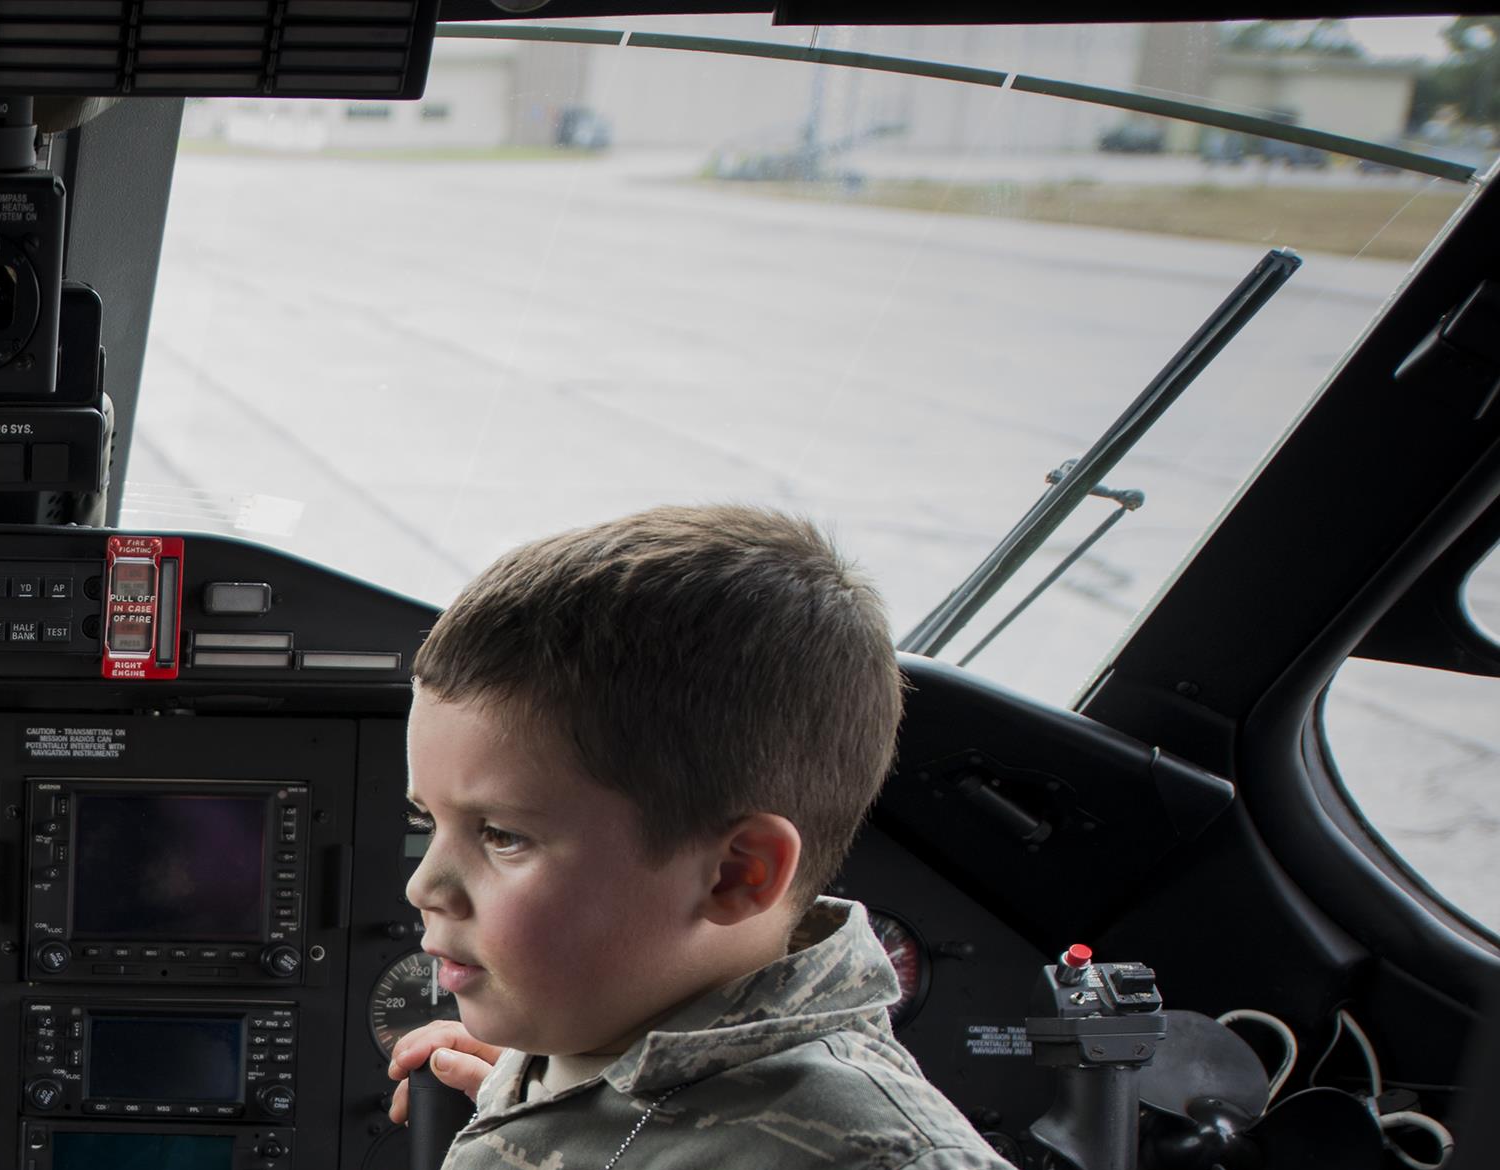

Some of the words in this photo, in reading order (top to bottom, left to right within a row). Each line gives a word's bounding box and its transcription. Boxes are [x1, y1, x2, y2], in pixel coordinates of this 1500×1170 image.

[2, 203, 35, 212] HEATING
[25, 212, 38, 221] ON
[10, 424, 34, 435] SYS.
[118, 546, 153, 554] FIGHTING
[20, 583, 33, 593] YD
[53, 583, 66, 593] AP
[110, 594, 133, 603] PULL
[137, 594, 156, 604] OFF
[113, 604, 124, 613] IN
[128, 604, 153, 613] CASE
[113, 614, 126, 623] OF
[129, 615, 152, 624] FIRE
[13, 623, 33, 633] HALF
[47, 627, 68, 637] TEST
[12, 632, 36, 642] BANK
[114, 661, 143, 670] RIGHT
[111, 669, 146, 678] ENGINE
[26, 728, 56, 736] CAUTION
[64, 728, 113, 737] TRANSMITTING
[115, 729, 126, 737] ON
[410, 967, 430, 977] 260
[386, 998, 406, 1008] 220
